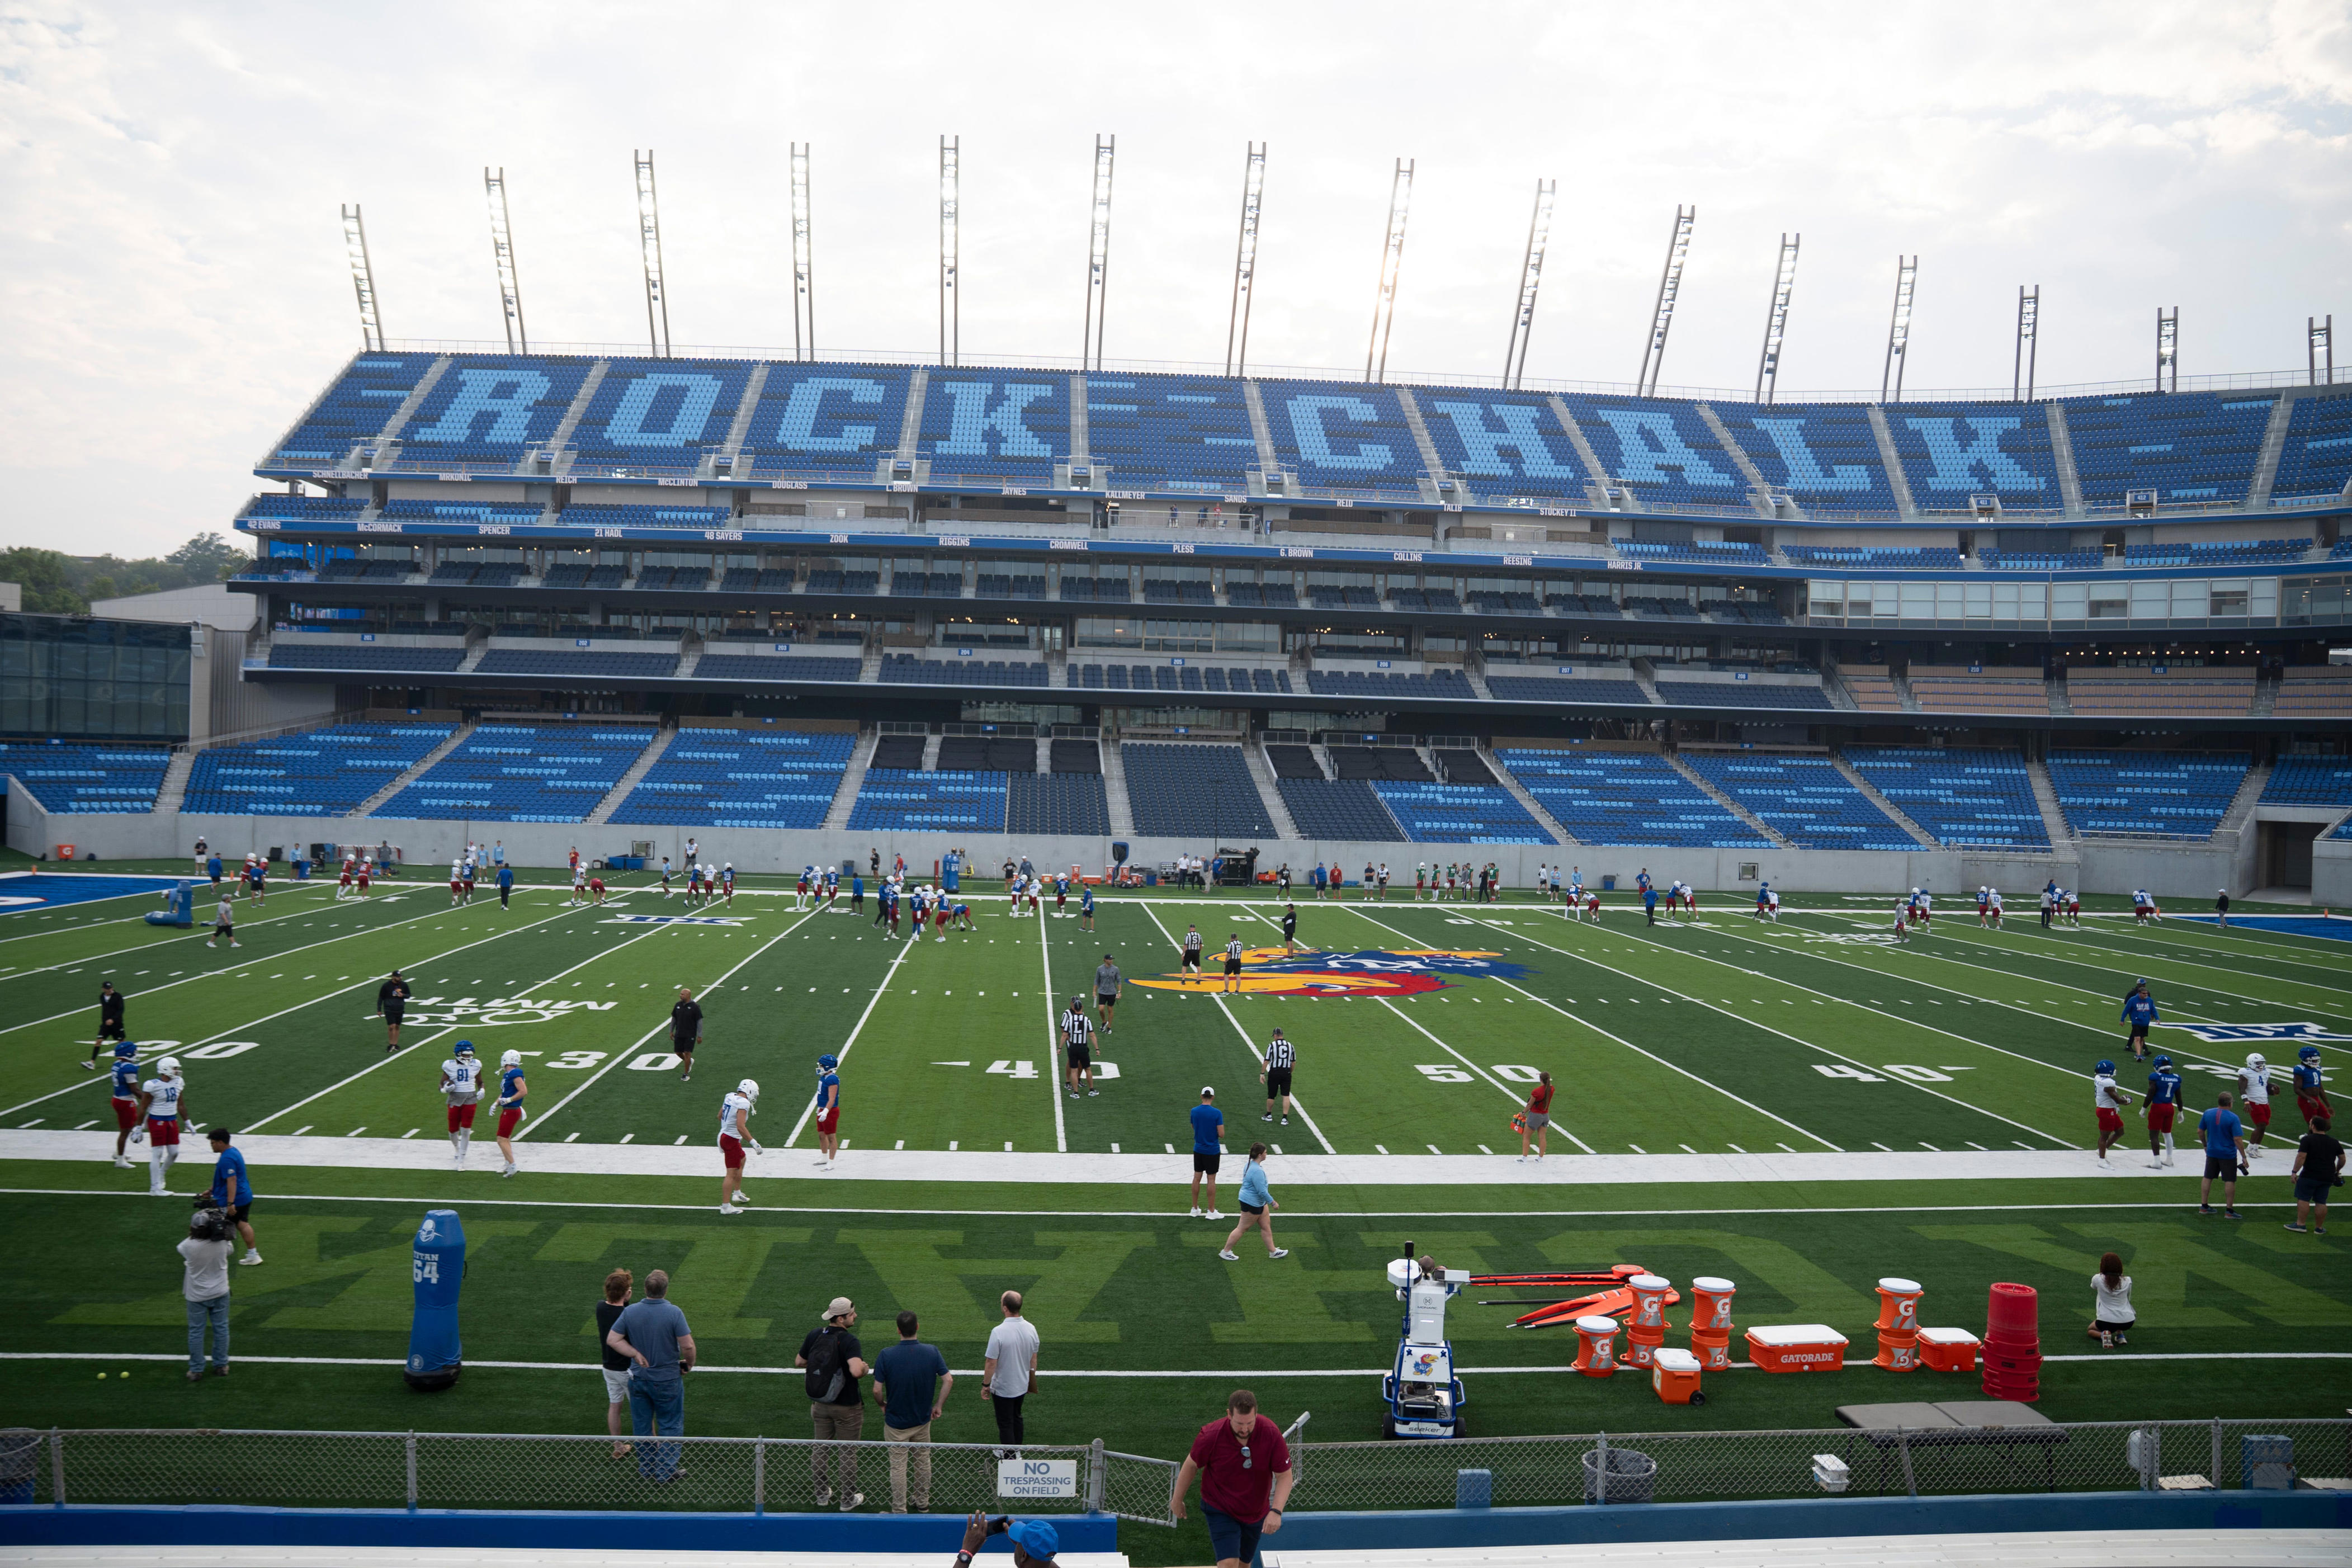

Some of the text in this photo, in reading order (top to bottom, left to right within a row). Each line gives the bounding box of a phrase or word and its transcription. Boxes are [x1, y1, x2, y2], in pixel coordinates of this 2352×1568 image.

[413, 367, 2047, 492] ROCK CHALK
[312, 470, 369, 480] SCHNELLBACHER
[438, 473, 472, 482] MRKONIC
[556, 475, 577, 484] REICH
[658, 478, 698, 487] McCLINTON
[772, 481, 808, 490] DOUGLASS
[893, 484, 918, 493] BROWN
[1001, 487, 1027, 496] JAYNES
[1105, 490, 1145, 500] KALLMEYER
[1224, 495, 1247, 503] SANDS
[1336, 499, 1353, 508] REID
[1443, 503, 1462, 512] TALIB
[1539, 507, 1569, 516] STUCKEY
[247, 520, 281, 530] 42 EVANS
[357, 523, 403, 533] McCORMACK
[479, 526, 510, 535] SPENCER
[595, 528, 623, 538] 21 HADL
[705, 531, 743, 541] 48 SAYERS
[829, 535, 849, 544] ZOOK
[939, 537, 970, 546] RIGGINS
[1050, 541, 1089, 550] CROMWELL
[1173, 545, 1194, 554] PLESS
[1280, 548, 1314, 558] G. BROWN
[1394, 552, 1423, 562] COLLINS
[1503, 556, 1532, 566] REESING
[1607, 561, 1643, 570] HARRIS JR.
[1074, 1021, 1081, 1033] L
[1278, 1045, 1287, 1058] C
[457, 1069, 469, 1082] 81
[2259, 1075, 2264, 1086] 4
[165, 1087, 177, 1102] 18
[2165, 1082, 2173, 1098] 1
[414, 1250, 439, 1262] TITAN
[413, 1259, 440, 1284] 64
[1643, 1296, 1658, 1314] G
[1717, 1297, 1730, 1315] G
[1898, 1300, 1914, 1316] G
[1595, 1338, 1610, 1356] G
[1780, 1352, 1834, 1363] GATORADE
[1023, 1462, 1050, 1475] NO
[1003, 1476, 1071, 1485] TRESPASSING
[1013, 1486, 1060, 1495] ON FIELD
